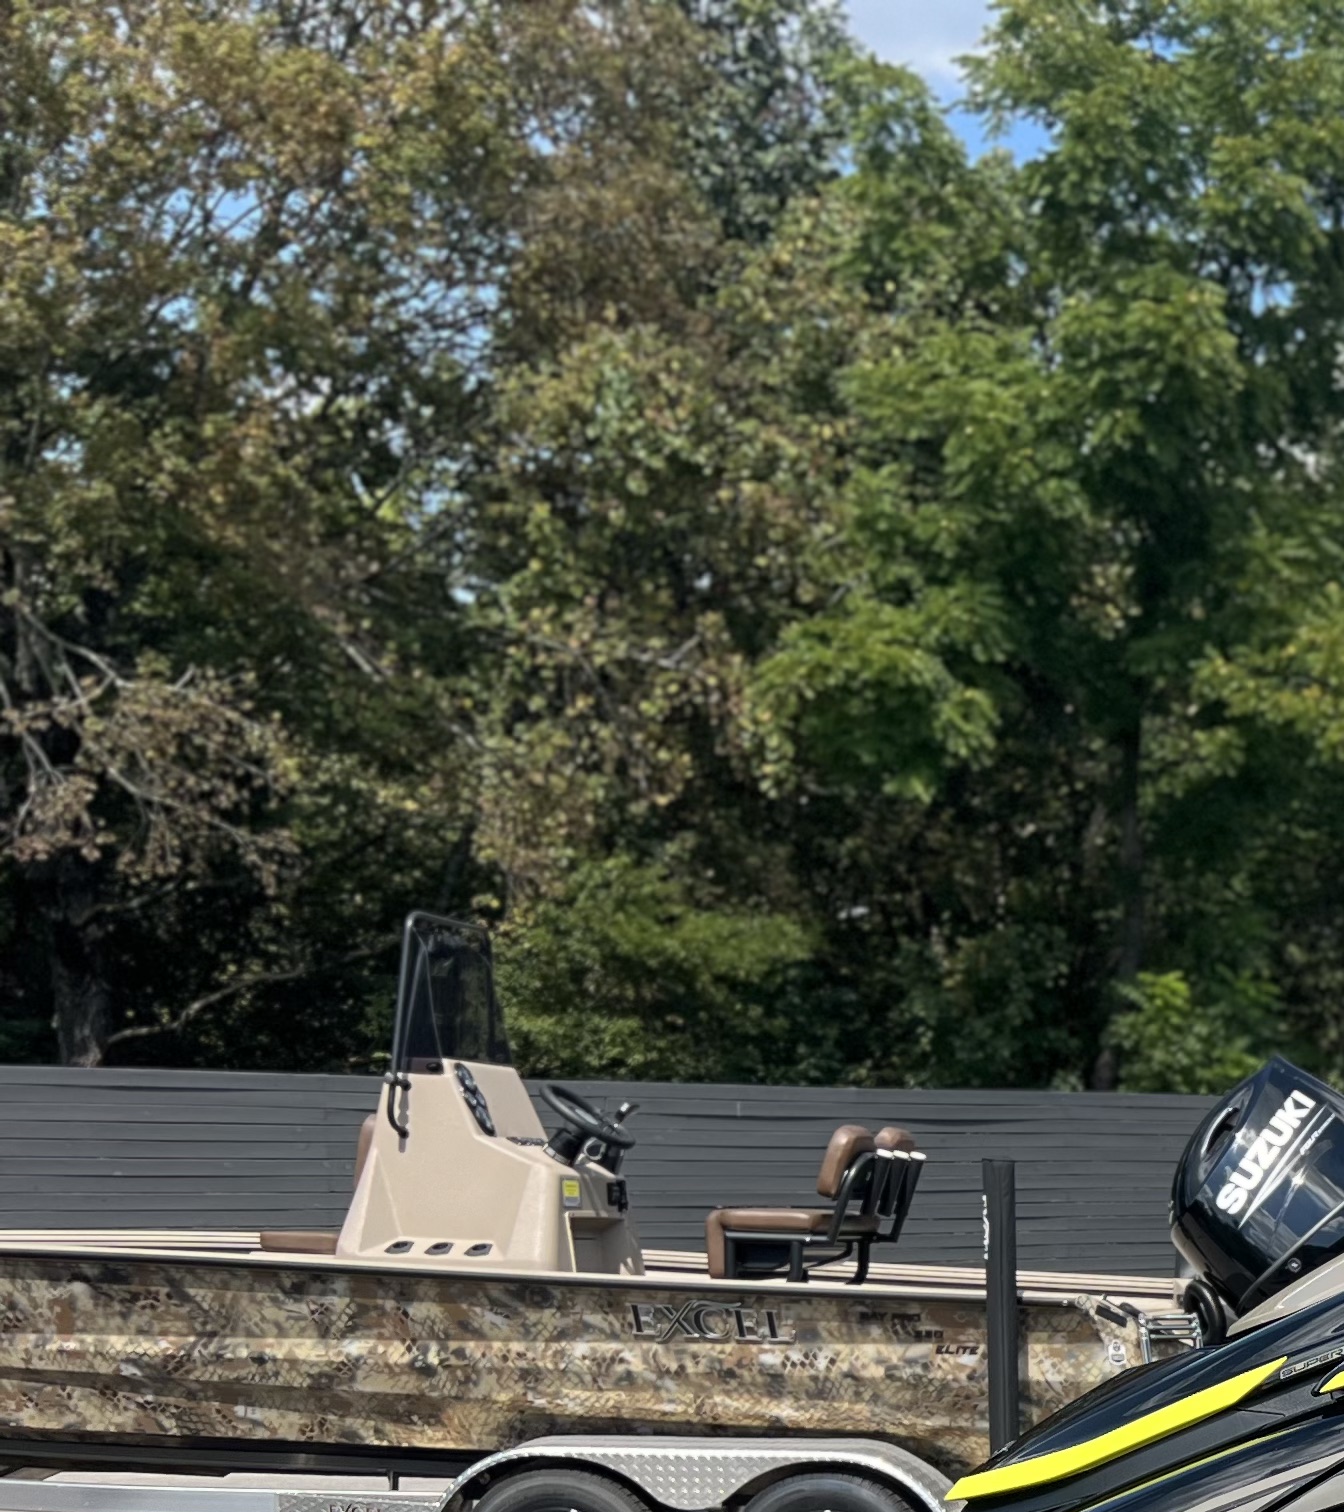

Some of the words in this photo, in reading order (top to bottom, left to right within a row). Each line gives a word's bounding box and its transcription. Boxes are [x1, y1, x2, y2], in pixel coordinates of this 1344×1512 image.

[1216, 1089, 1316, 1214] SUZUKI
[627, 1300, 796, 1344] EXCEL
[935, 1343, 980, 1355] ELITE
